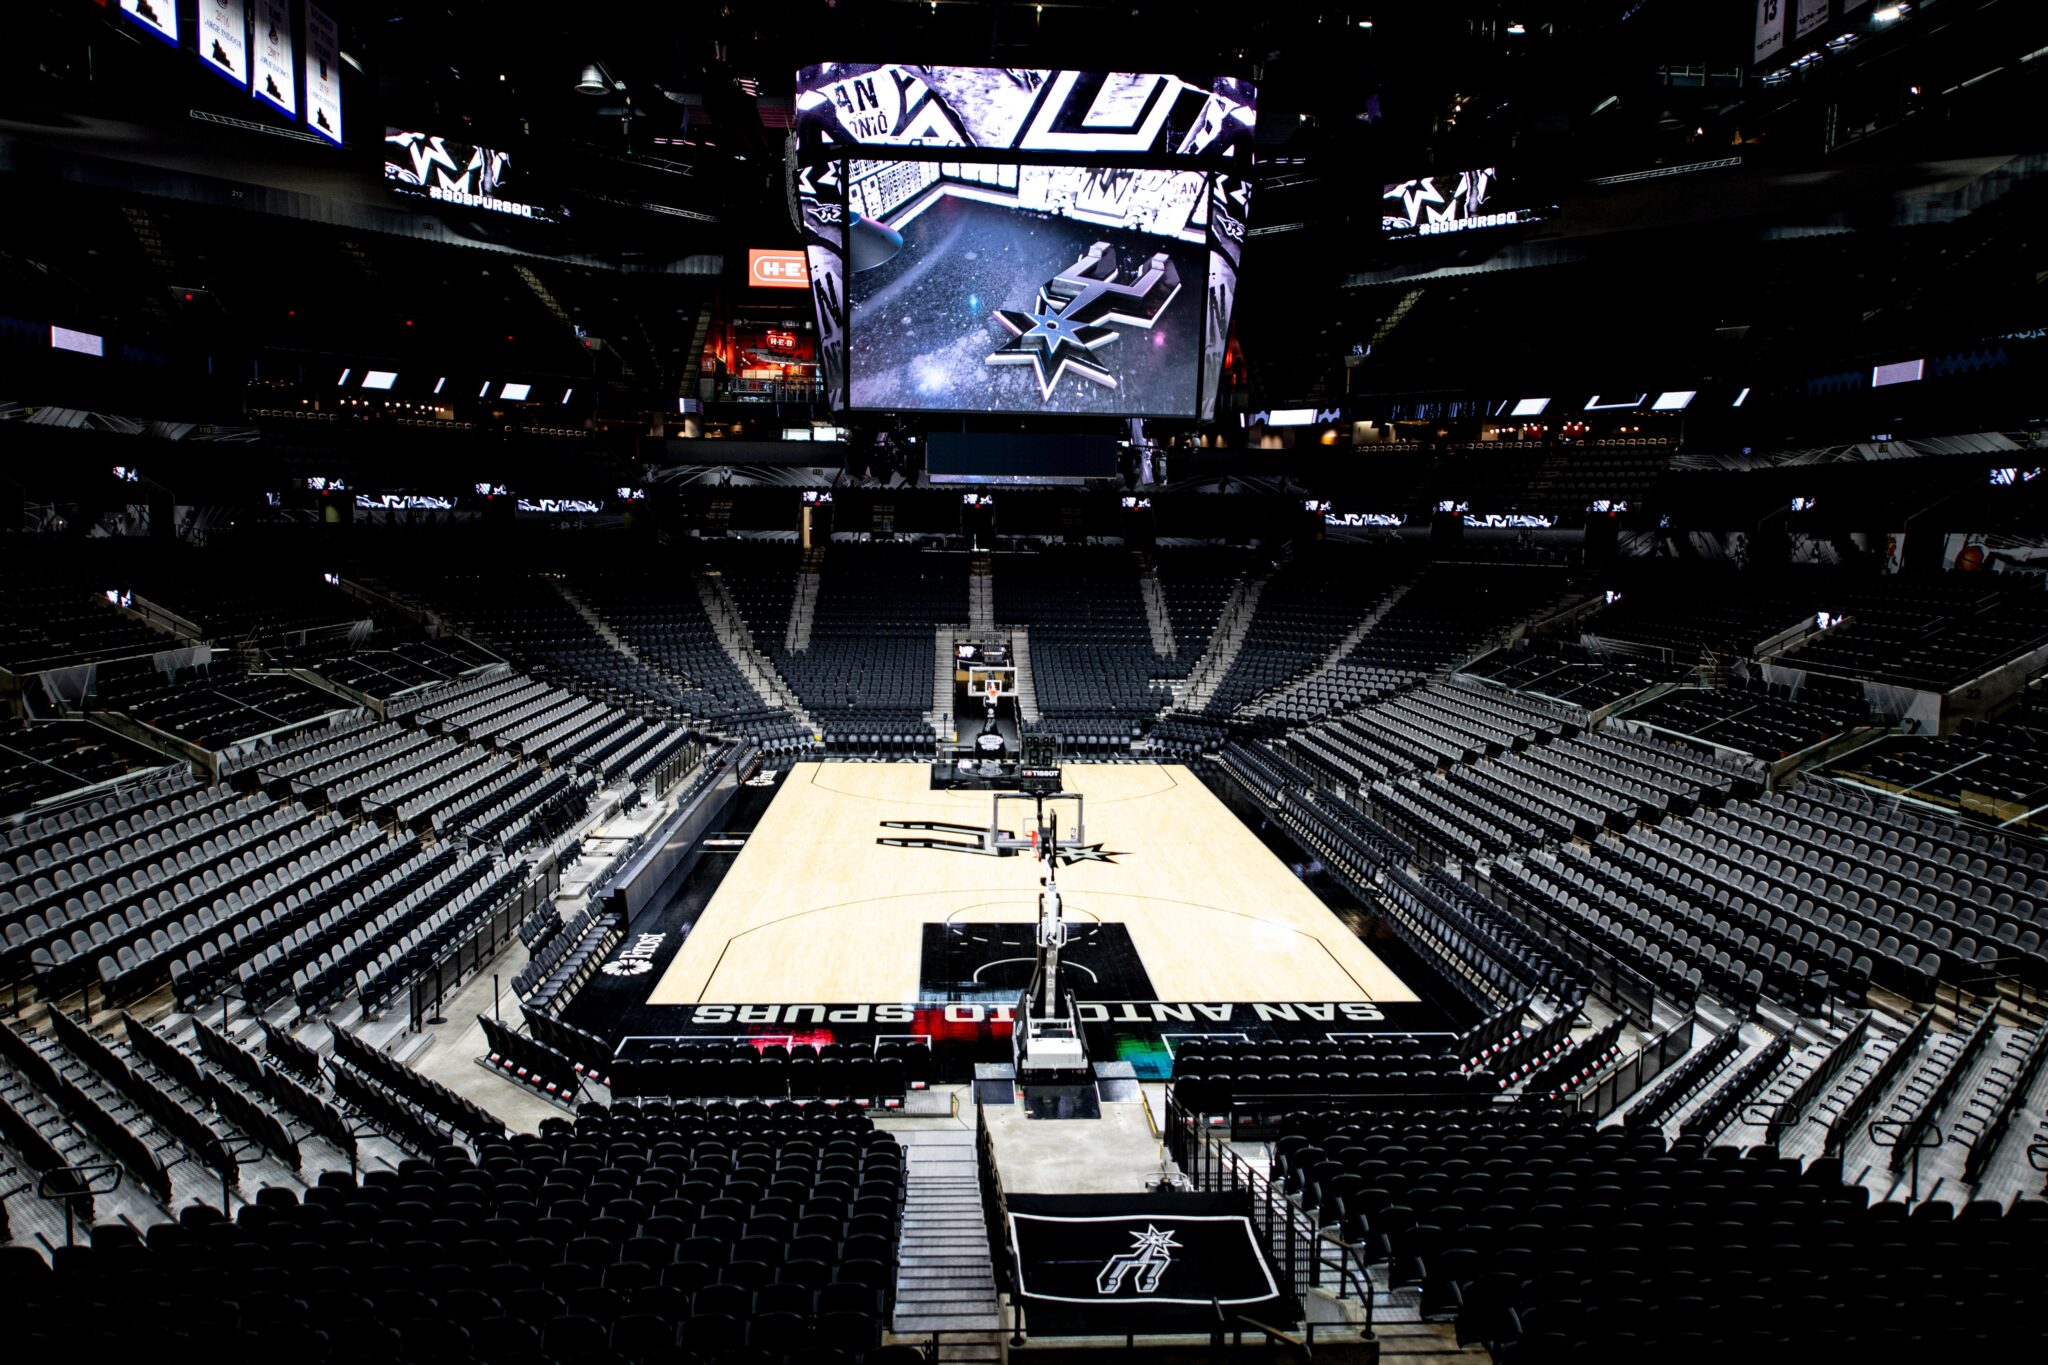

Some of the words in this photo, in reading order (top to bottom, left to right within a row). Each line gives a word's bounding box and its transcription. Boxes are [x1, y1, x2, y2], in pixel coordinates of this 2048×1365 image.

[1763, 0, 1777, 25] 13
[430, 186, 532, 218] #GOSPURSGO
[1419, 211, 1518, 235] #GOSPURSGO
[770, 338, 793, 347] H-E-B
[619, 932, 667, 959] Frost
[691, 1004, 915, 1023] SPURS
[1252, 1003, 1386, 1023] SAN
